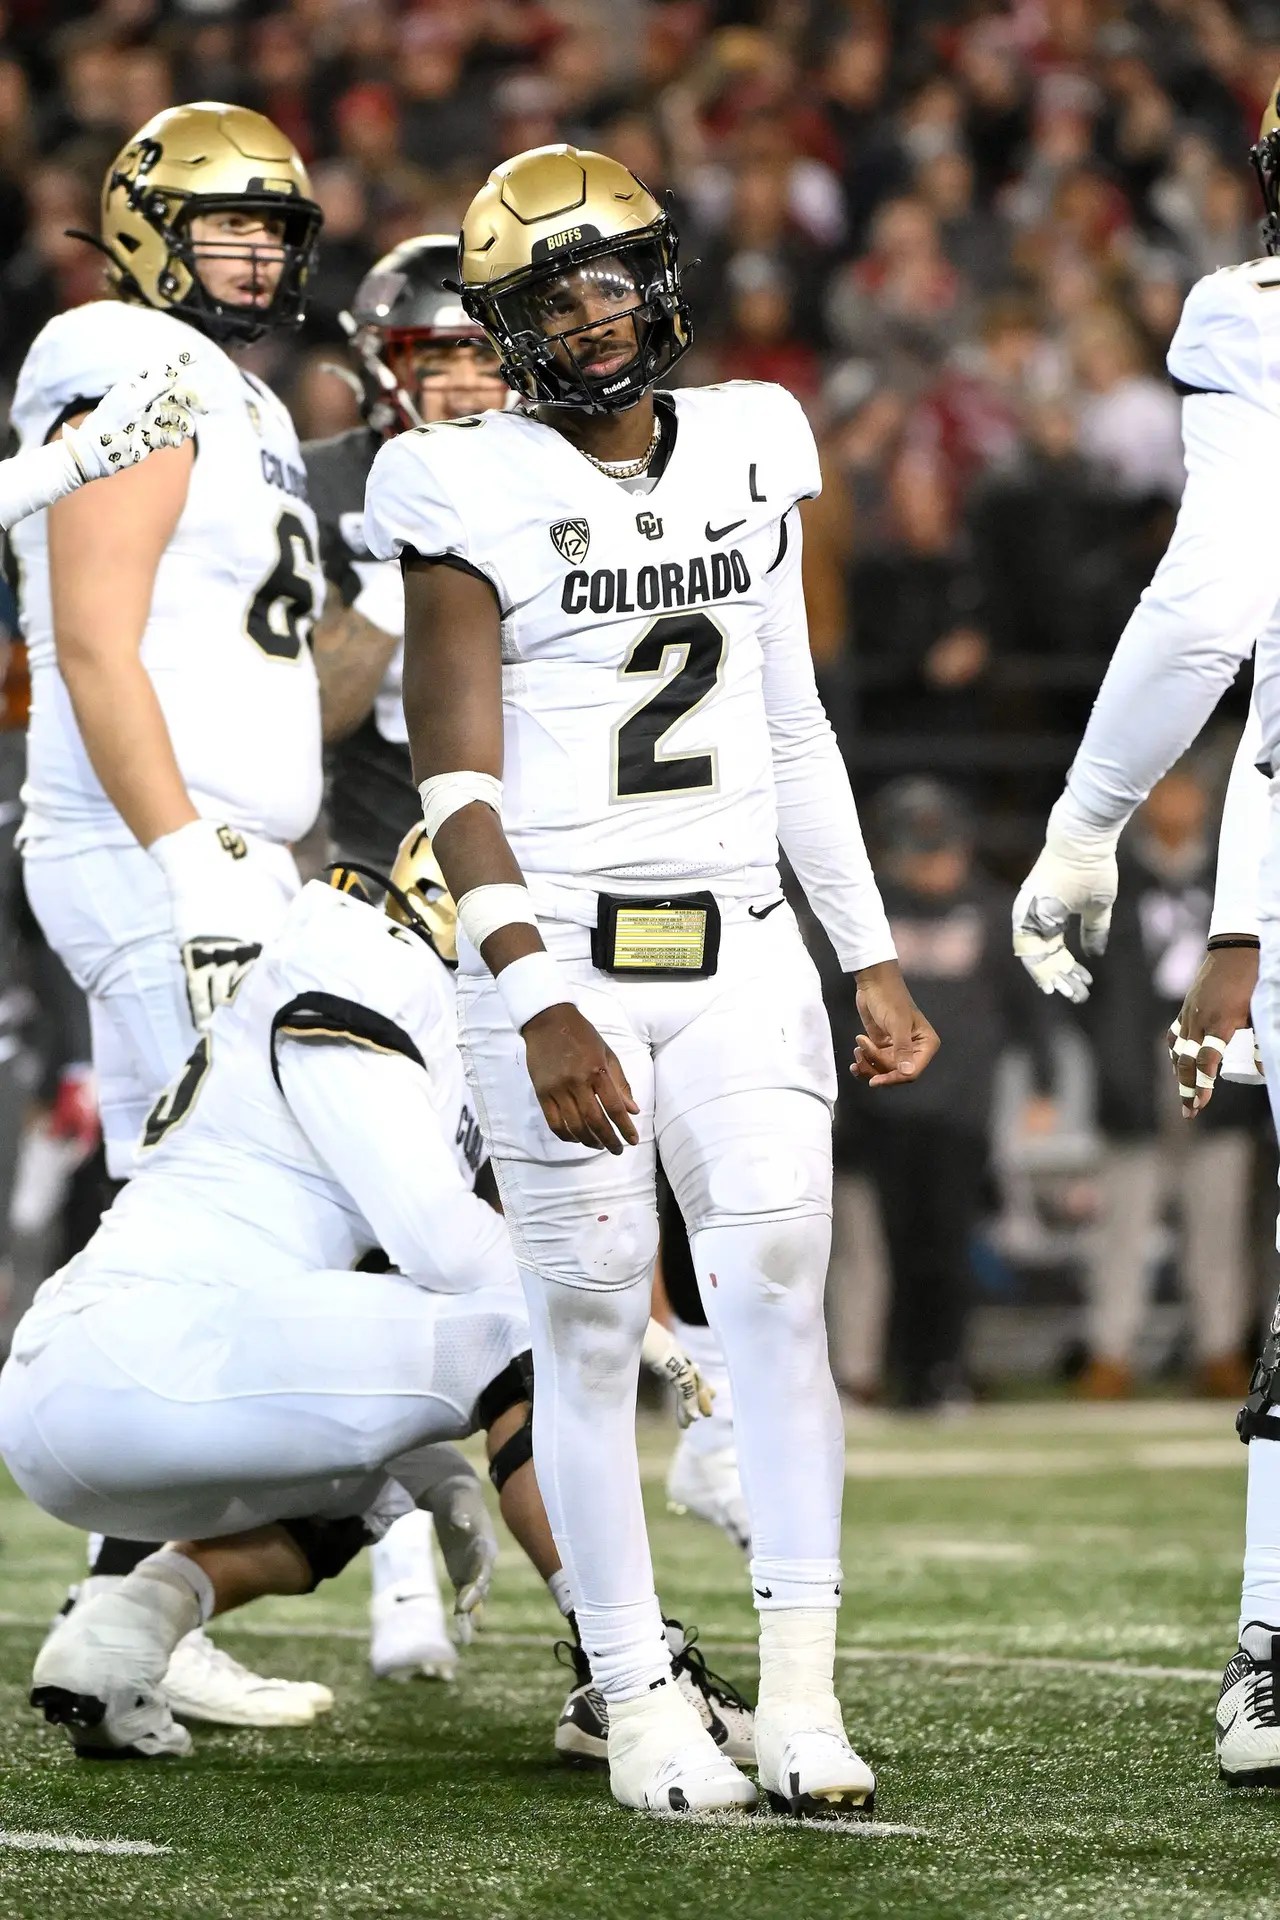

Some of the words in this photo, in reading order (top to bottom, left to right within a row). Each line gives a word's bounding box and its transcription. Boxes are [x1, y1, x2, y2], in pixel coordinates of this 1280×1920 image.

[546, 227, 582, 250] BUFFS
[602, 377, 631, 395] Riddell
[552, 520, 588, 550] PAC
[635, 511, 664, 541] CU
[564, 538, 585, 557] 12
[560, 549, 751, 614] COLORADO
[611, 609, 728, 803] 2
